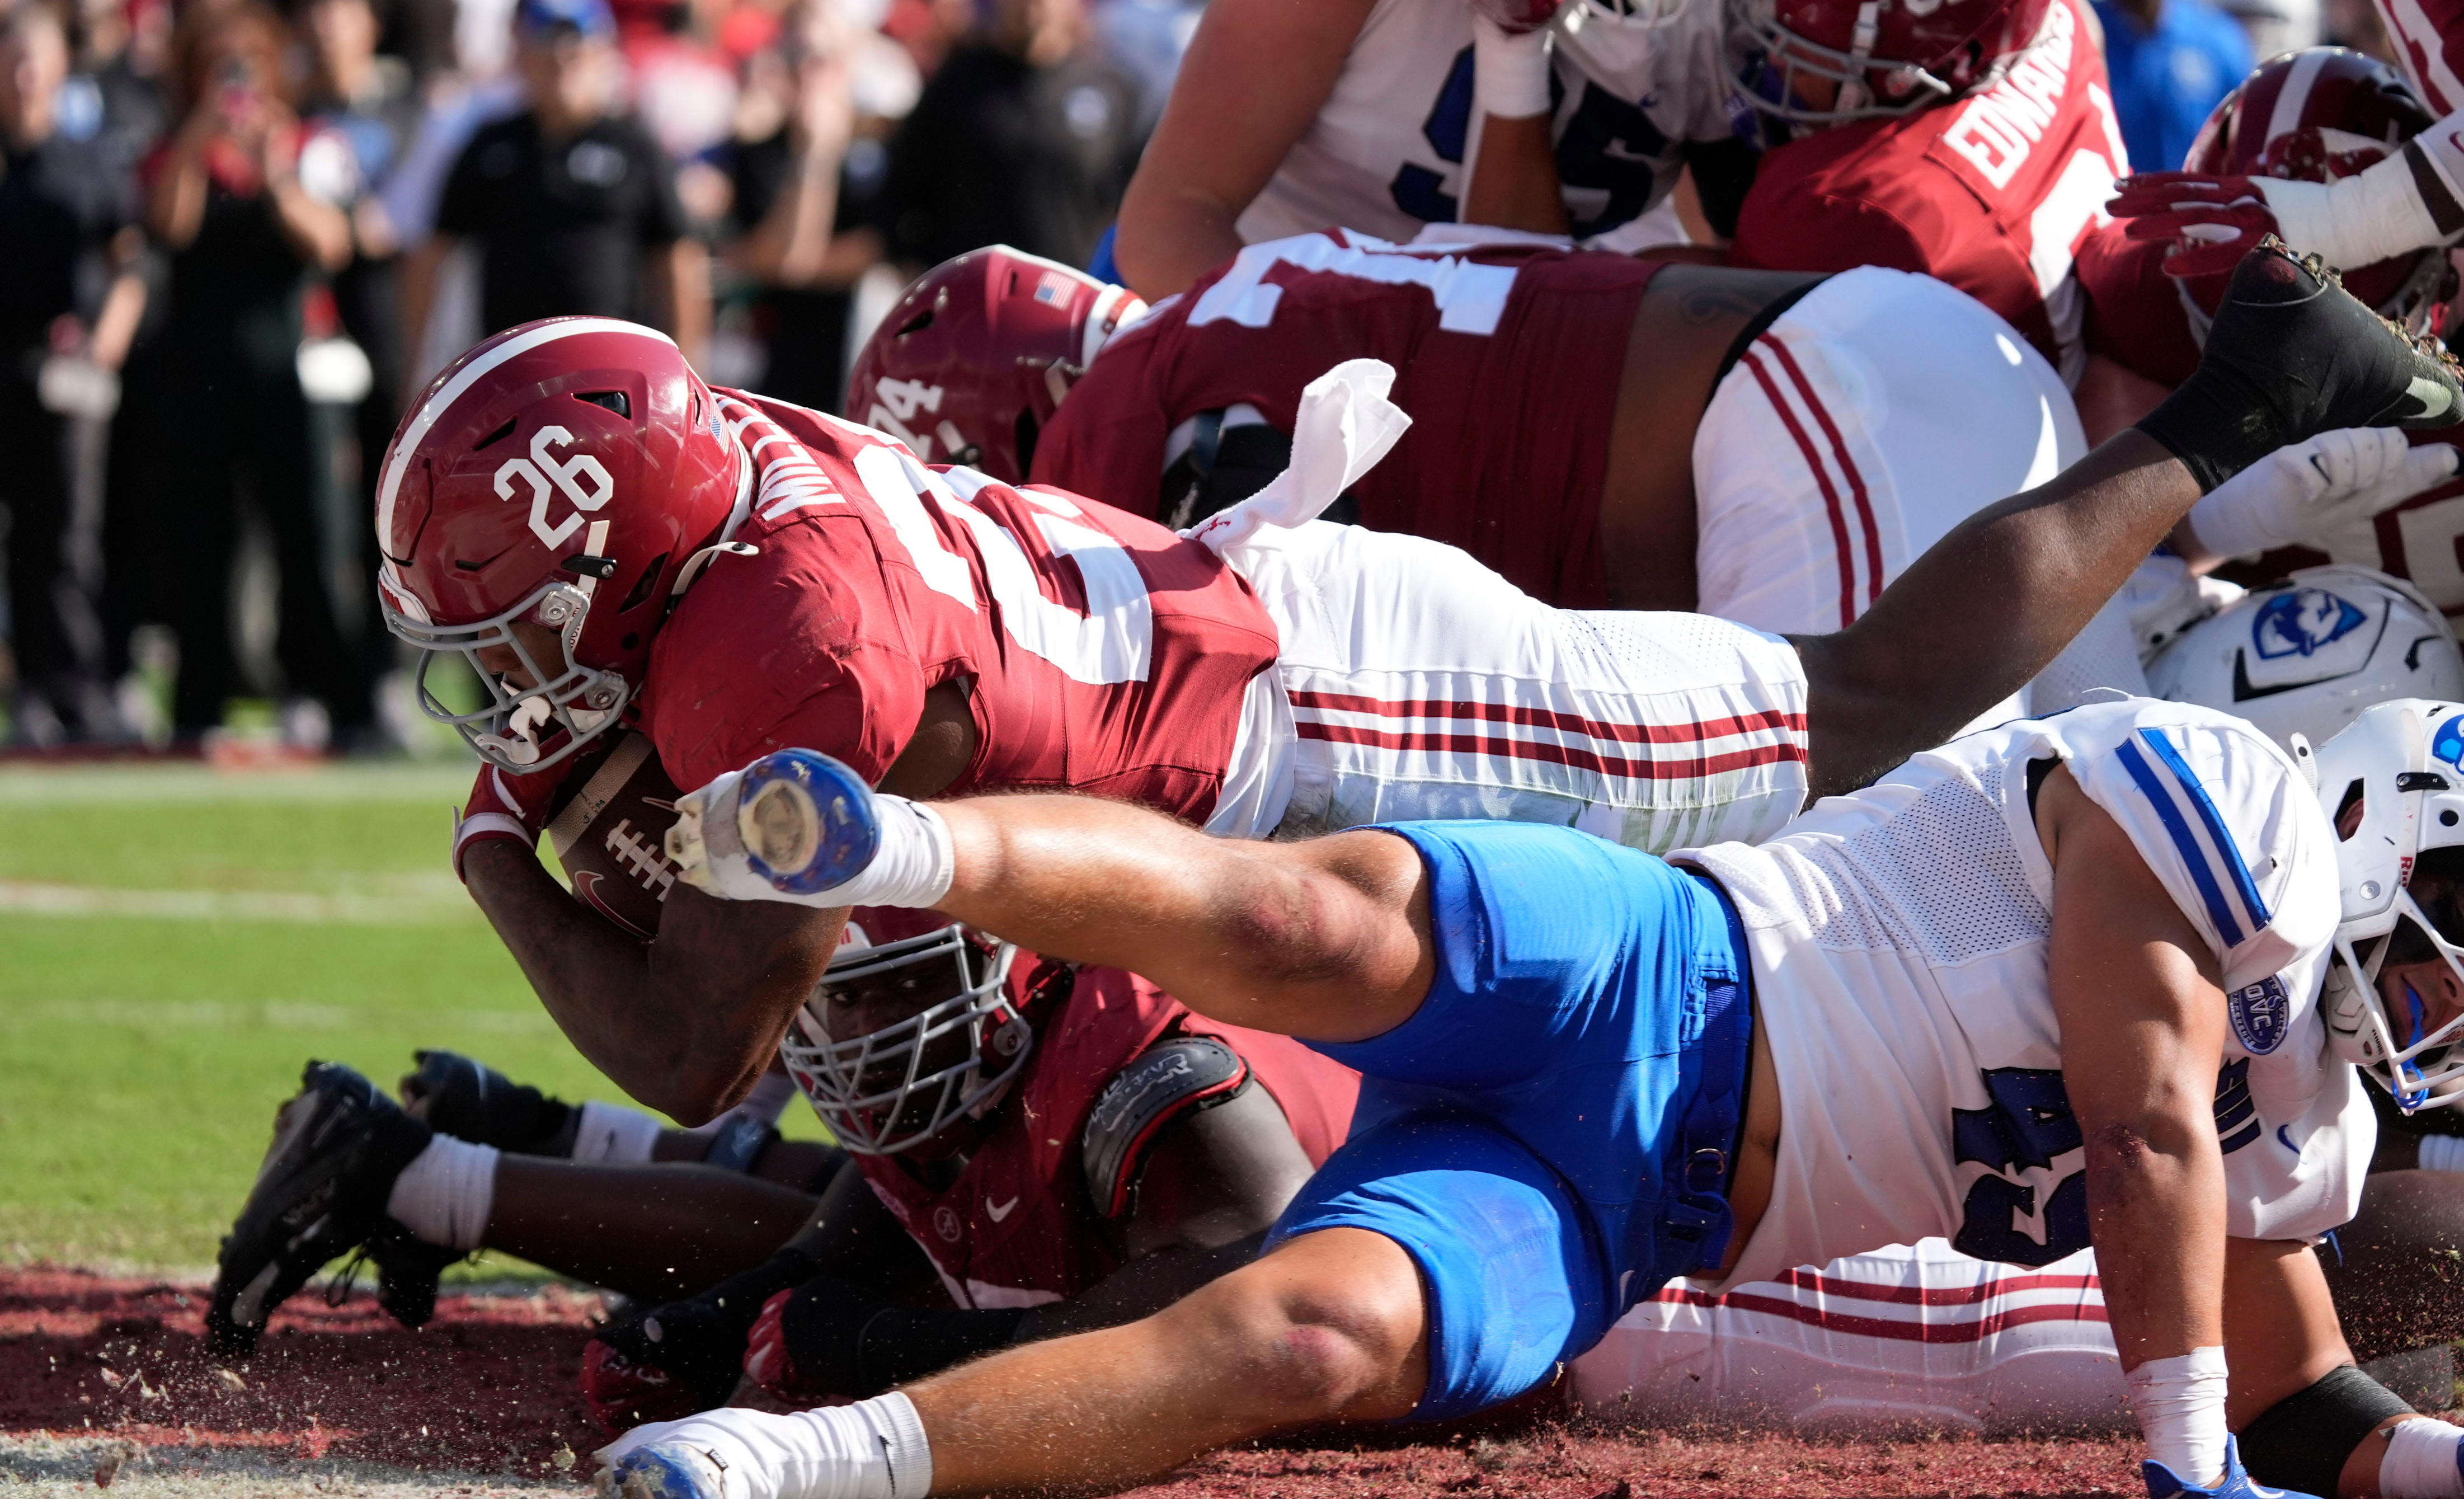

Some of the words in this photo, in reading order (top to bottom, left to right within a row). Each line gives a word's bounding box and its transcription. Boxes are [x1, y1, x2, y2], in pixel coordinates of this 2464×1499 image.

[1186, 226, 1561, 337] 7
[867, 375, 944, 464] 74
[493, 425, 614, 551] 26
[800, 407, 1153, 684] 2
[2244, 984, 2272, 1031] OVC
